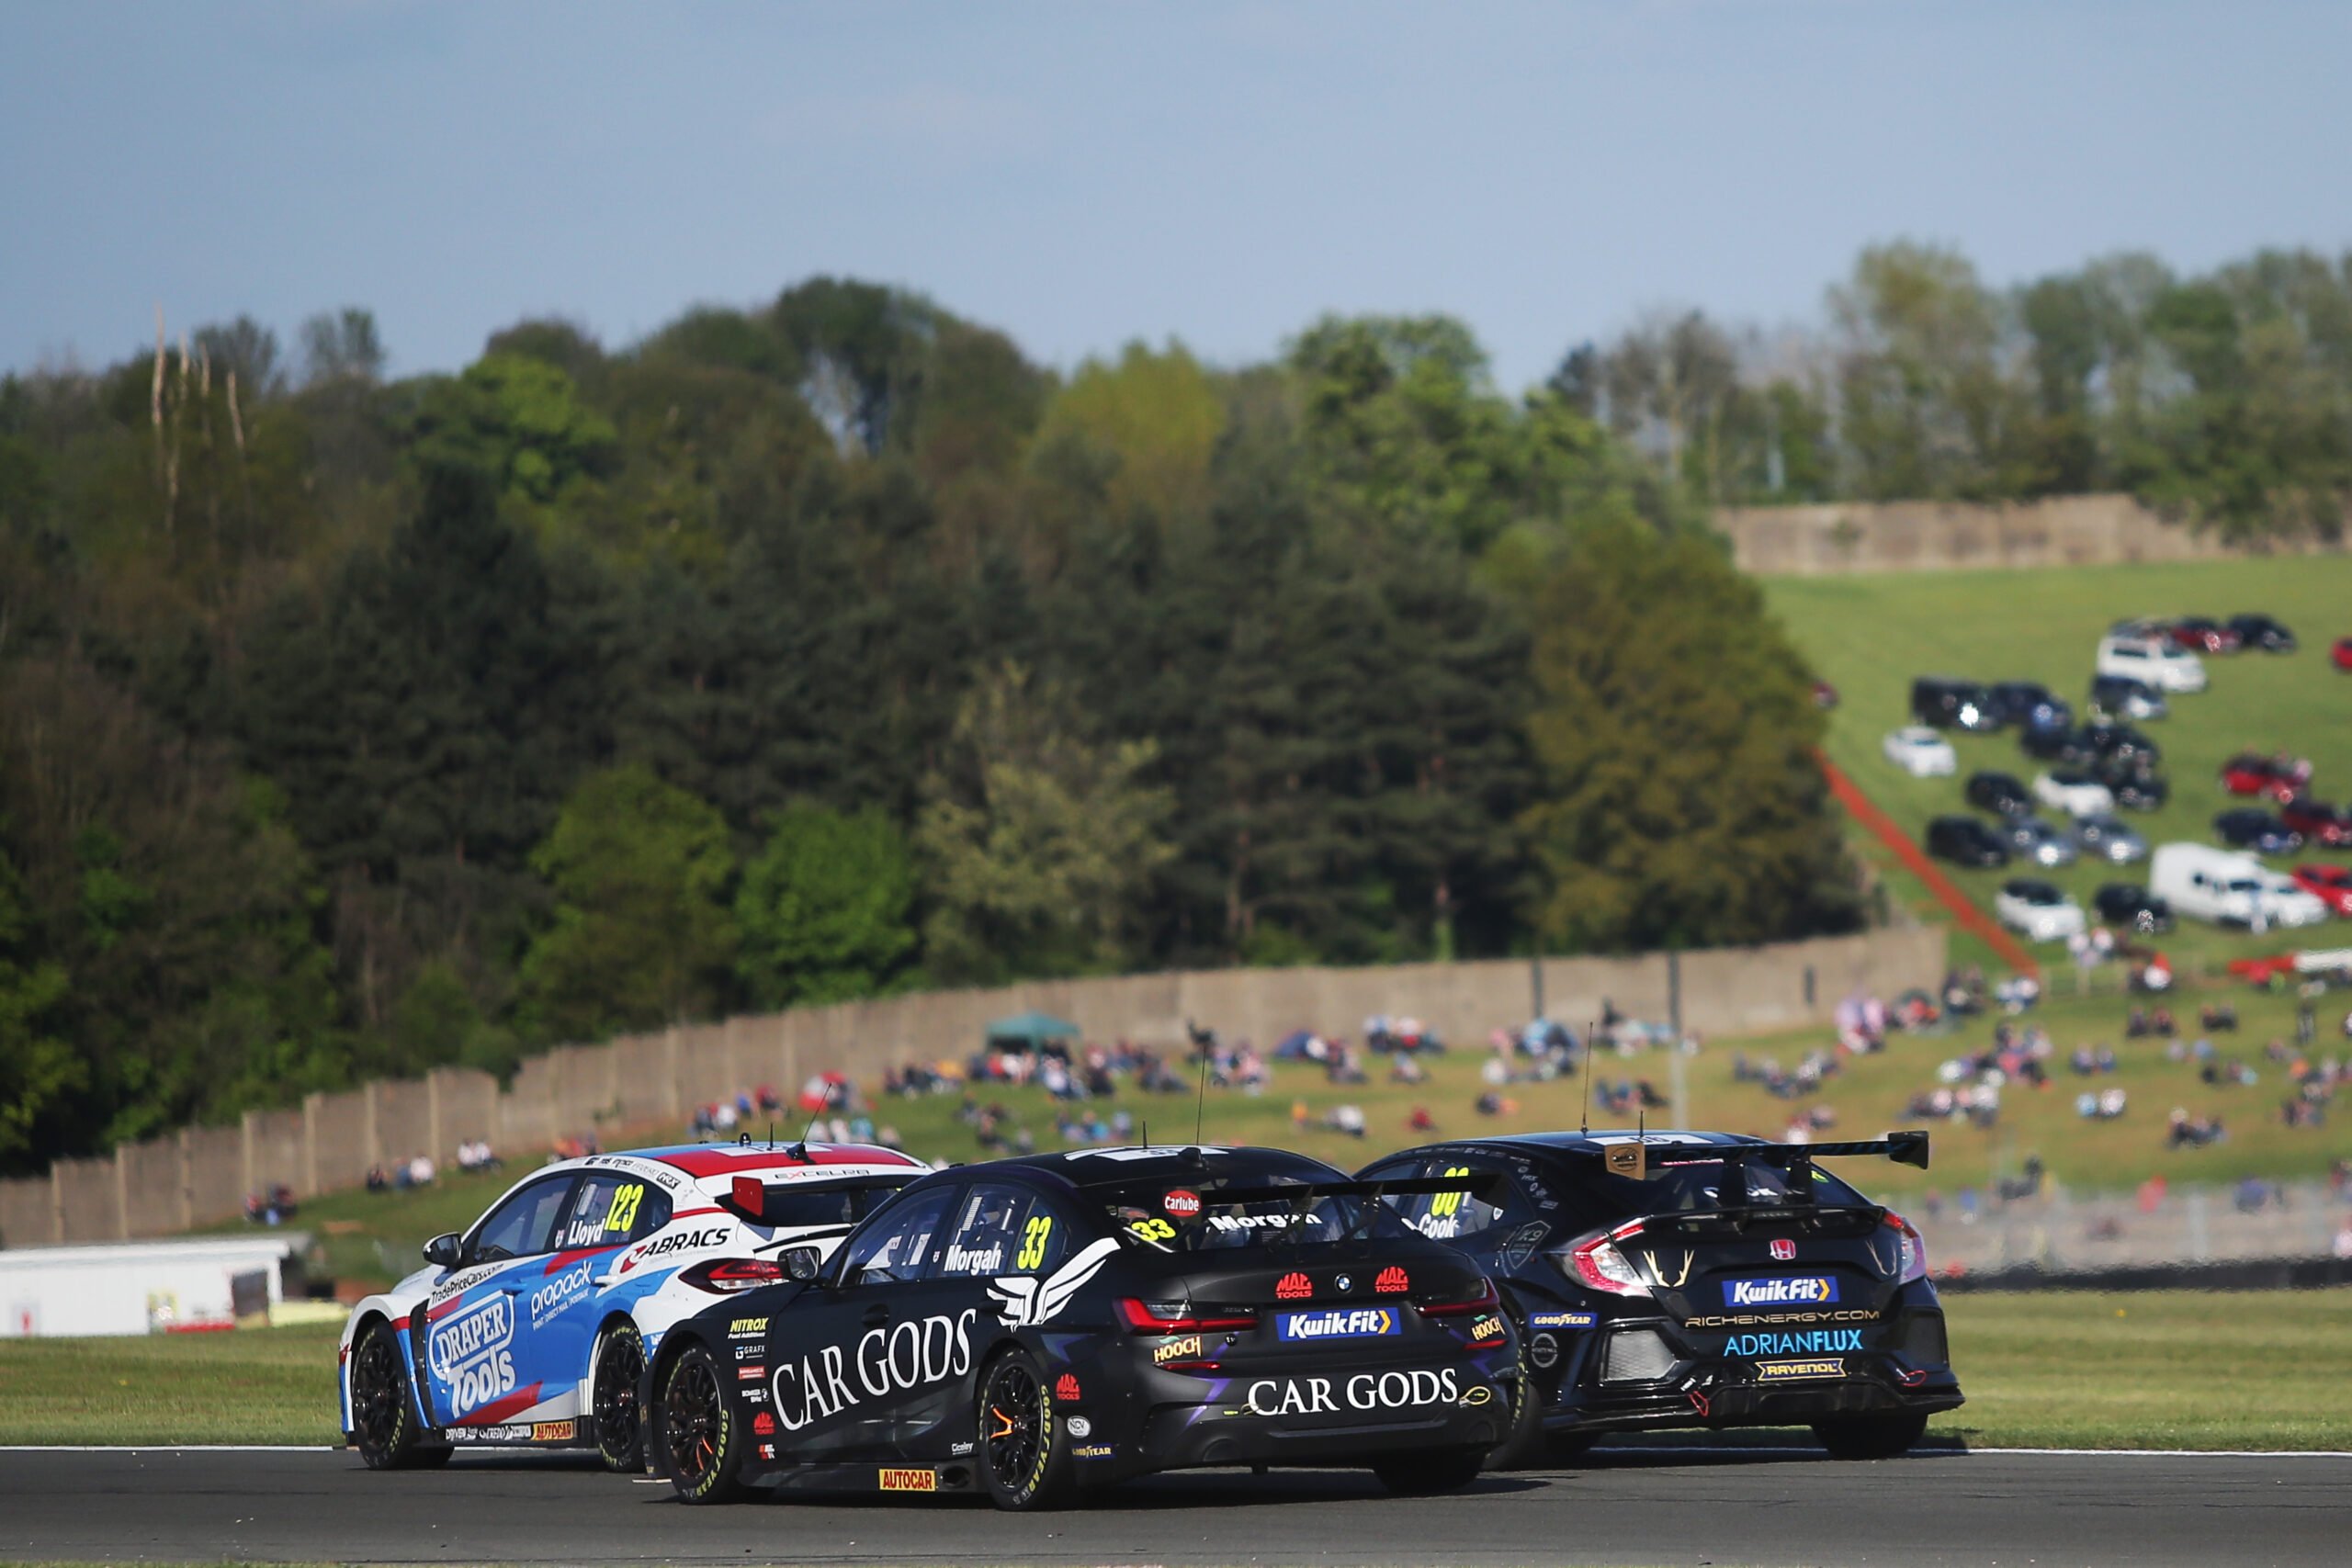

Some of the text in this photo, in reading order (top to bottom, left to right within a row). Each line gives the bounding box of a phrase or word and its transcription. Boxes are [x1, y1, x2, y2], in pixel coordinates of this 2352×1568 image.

[604, 1184, 644, 1232] 123
[1165, 1195, 1199, 1213] Carlube
[569, 1218, 605, 1245] Lloyd
[1131, 1218, 1176, 1241] 33
[1419, 1213, 1459, 1239] Cook
[639, 1228, 731, 1258] ABRACS
[1017, 1216, 1052, 1270] 33
[1276, 1272, 1312, 1291] MAC
[1375, 1266, 1408, 1285] MAC
[531, 1259, 593, 1320] propack
[1275, 1291, 1312, 1299] TOOLS
[729, 1317, 769, 1332] NITROX
[1472, 1316, 1507, 1341] HOOCH
[1534, 1314, 1591, 1326] GOODYEAR
[1685, 1309, 1880, 1328] RICHENERGY.COM
[436, 1302, 506, 1365] DRAPER
[1153, 1336, 1202, 1363] HOOCH
[773, 1345, 860, 1431] CAR
[857, 1308, 977, 1396] GODS
[1248, 1368, 1459, 1416] CAR GODS
[882, 1471, 933, 1491] AUTOCAR
